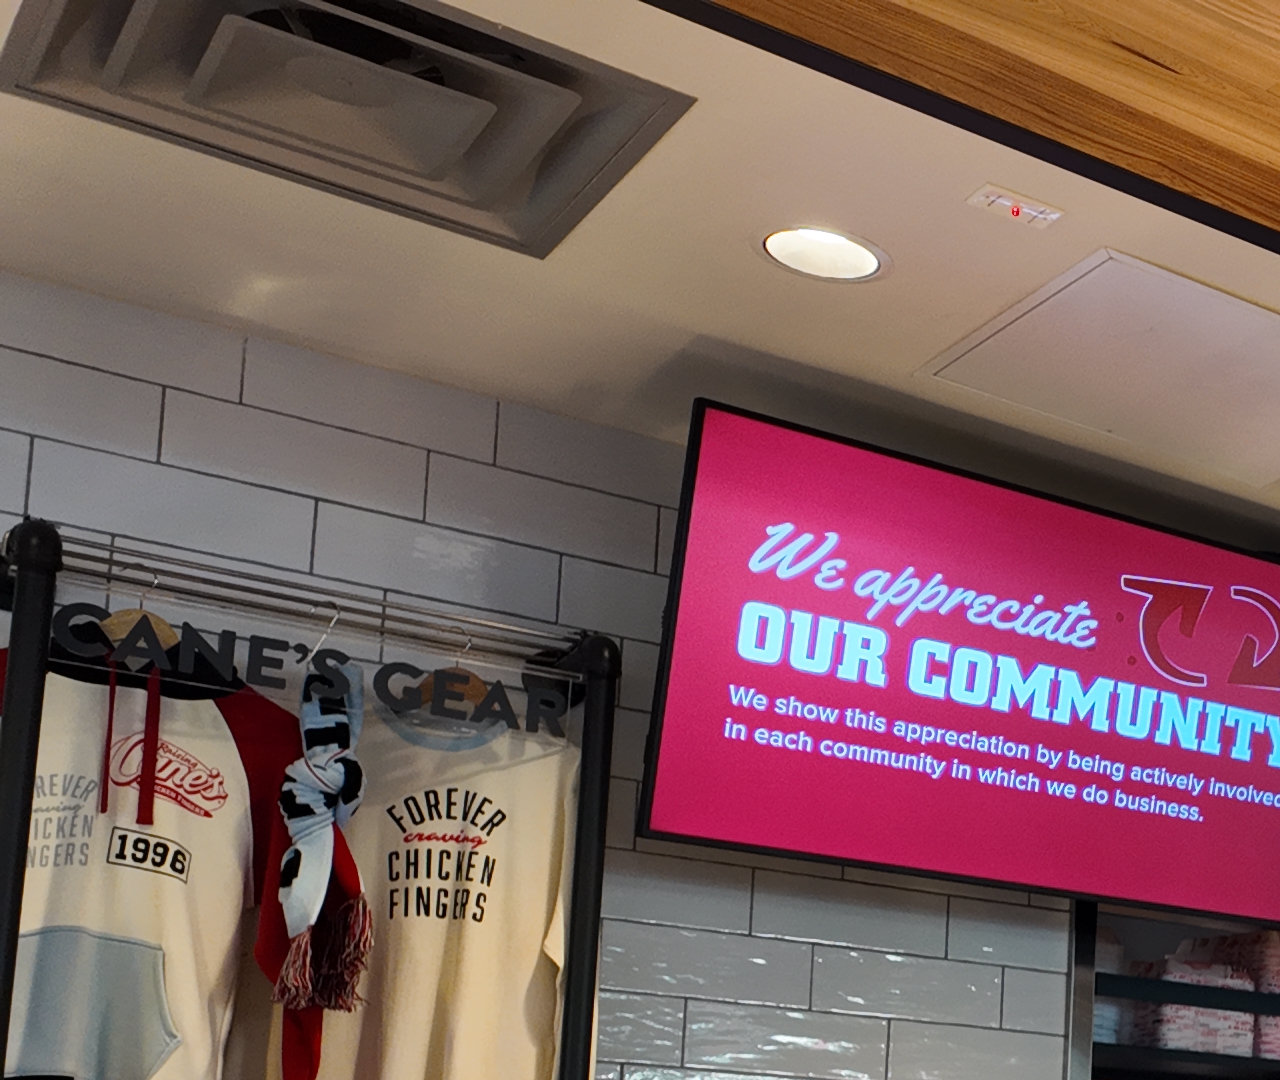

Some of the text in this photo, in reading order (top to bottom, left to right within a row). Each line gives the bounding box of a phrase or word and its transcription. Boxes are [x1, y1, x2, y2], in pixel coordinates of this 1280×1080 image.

[747, 522, 1100, 649] We appreciate
[52, 601, 568, 738] CANE'S GEAR
[736, 601, 888, 688] OUR
[110, 735, 229, 801] Cne's
[724, 719, 1206, 823] in each community in which we do business.
[729, 684, 768, 711] We
[775, 692, 838, 724] show
[845, 706, 887, 733] this
[892, 719, 1031, 762] appreciation
[1035, 740, 1062, 769] by
[1068, 750, 1125, 782] being
[1130, 761, 1205, 797] actively
[386, 787, 507, 837] FOREVER
[403, 829, 487, 849] craving
[114, 833, 187, 876] 1996
[387, 848, 497, 887] CHICKEN
[389, 886, 488, 923] FINGERS
